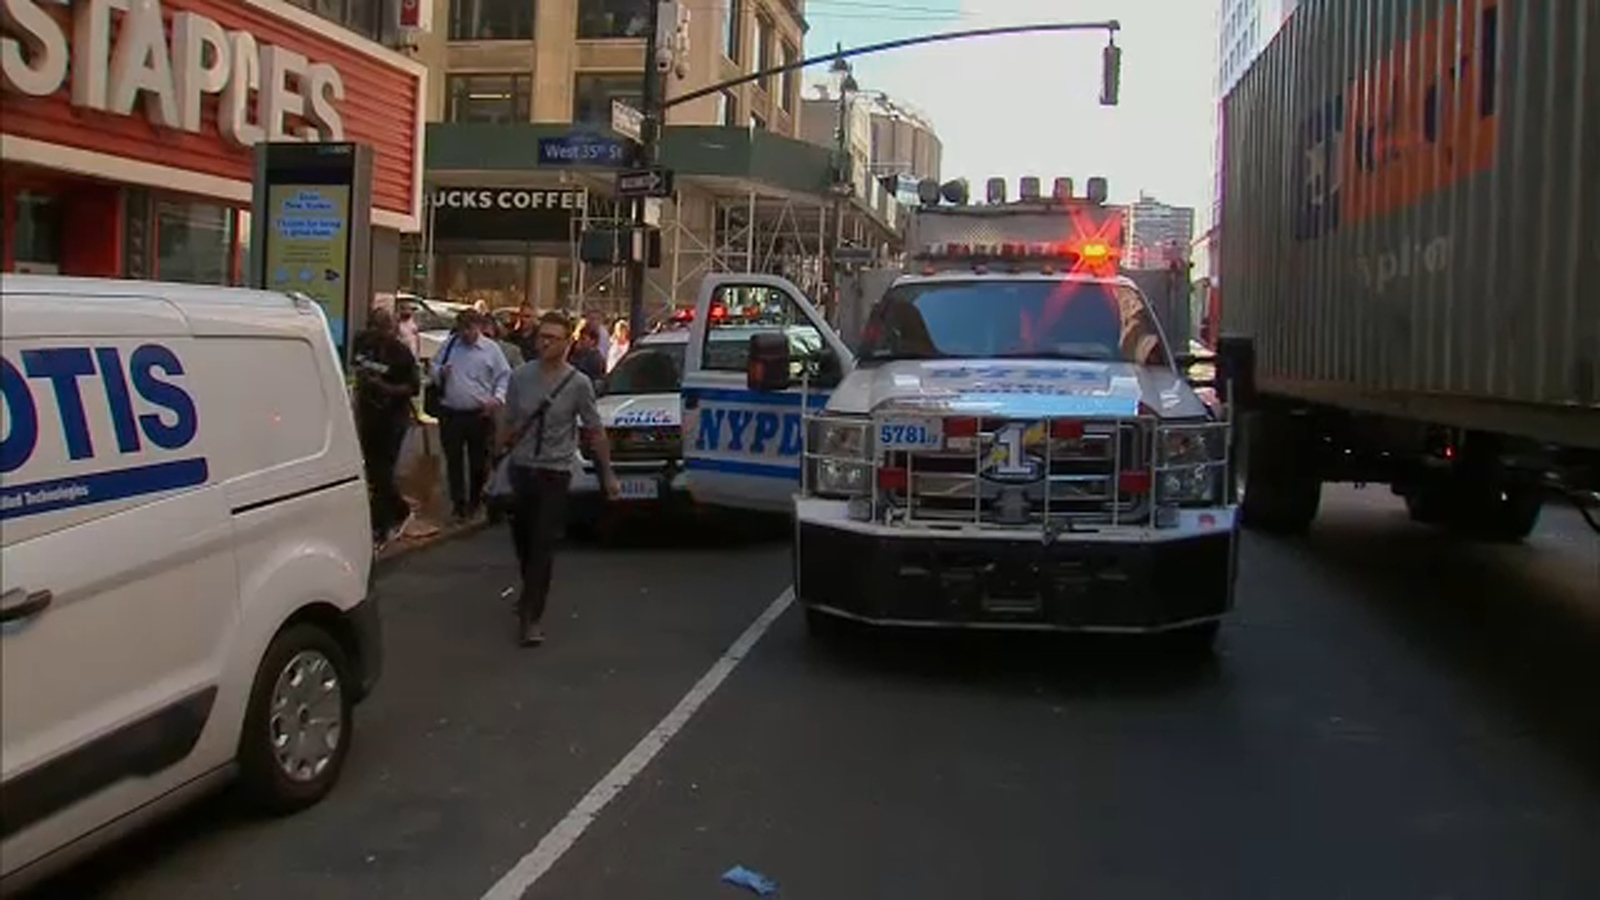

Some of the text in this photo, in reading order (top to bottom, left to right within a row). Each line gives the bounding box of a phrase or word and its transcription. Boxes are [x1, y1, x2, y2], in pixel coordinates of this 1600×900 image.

[1, 0, 345, 143] STAPLES
[544, 143, 579, 159] West
[609, 145, 623, 159] St
[497, 191, 587, 209] COFFEE
[695, 408, 803, 457] NYPD
[881, 424, 926, 444] 5781
